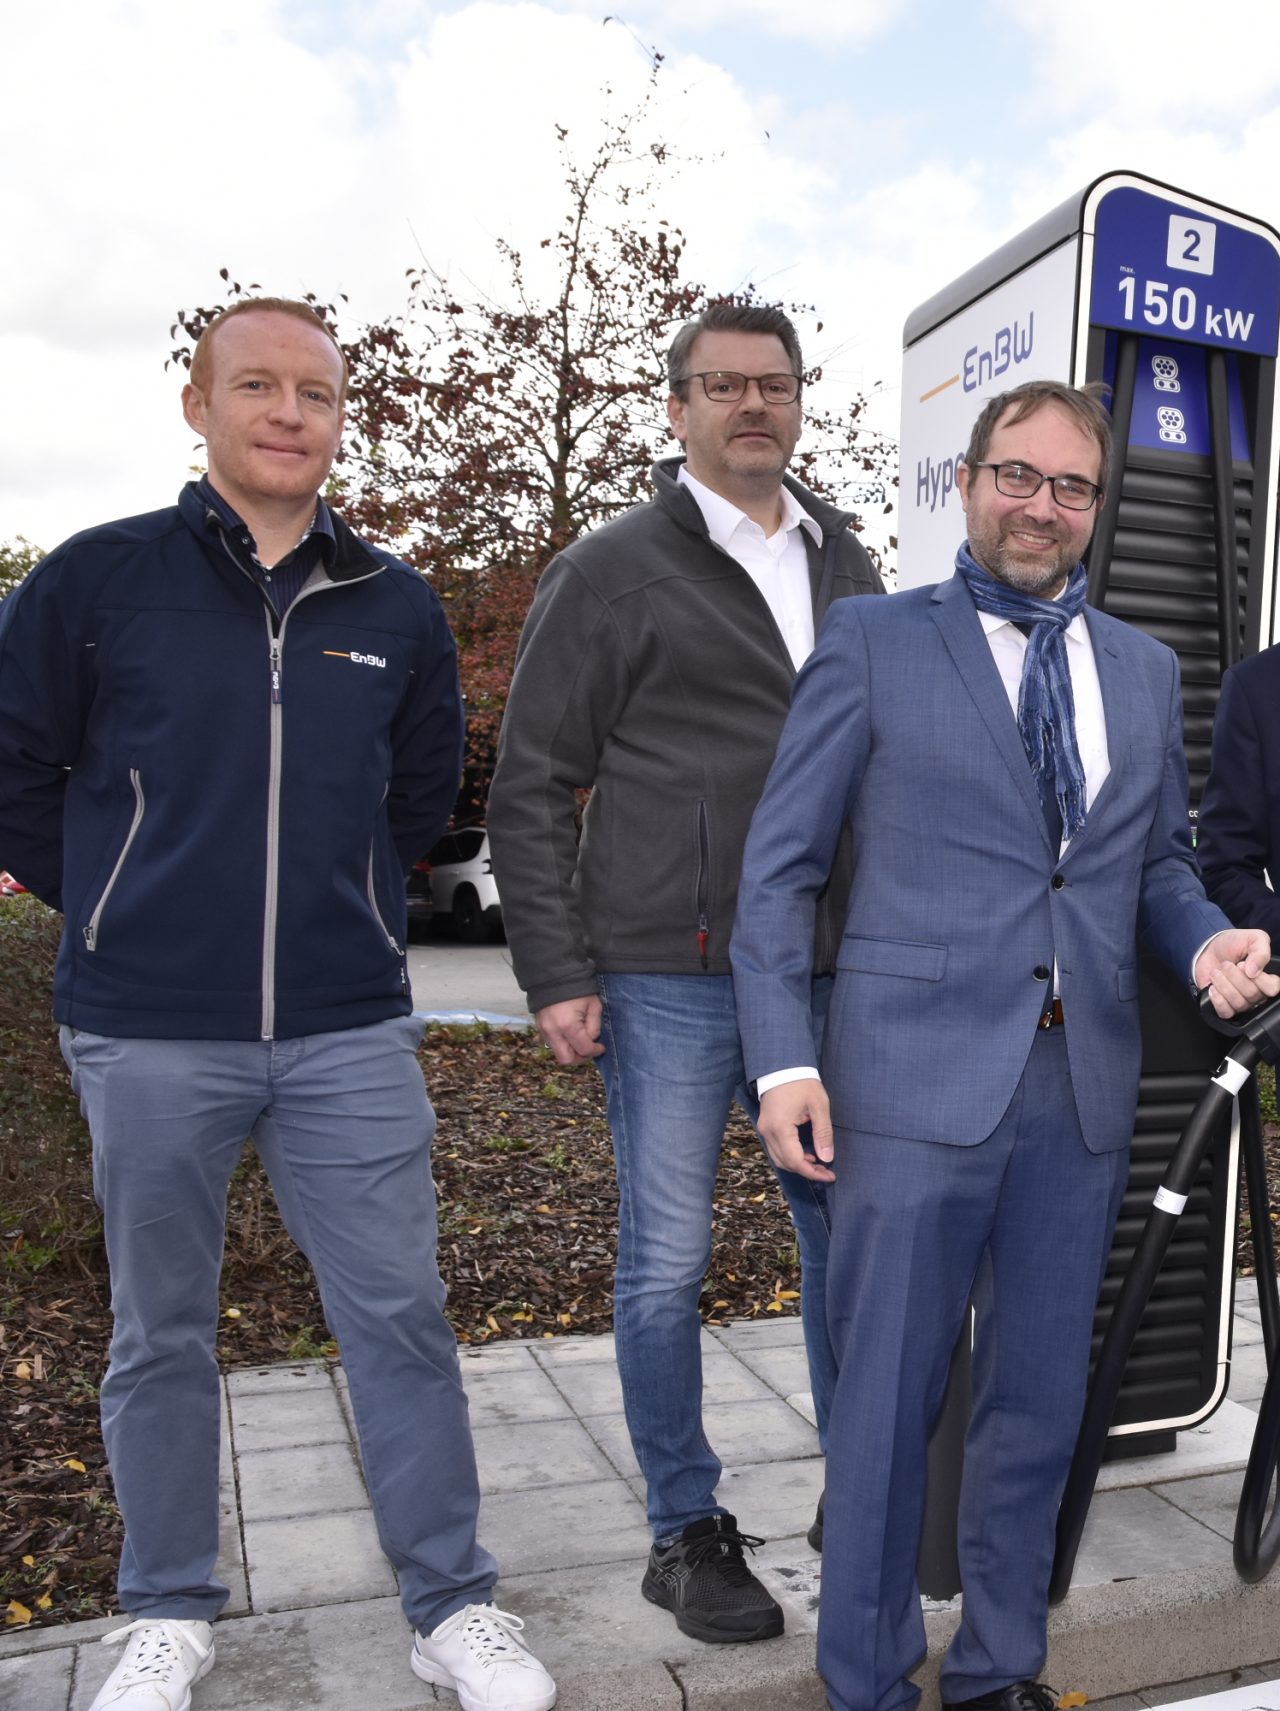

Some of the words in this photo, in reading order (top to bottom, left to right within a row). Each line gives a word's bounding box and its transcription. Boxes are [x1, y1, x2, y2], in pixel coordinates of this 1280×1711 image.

[1181, 228, 1202, 263] 2
[1118, 276, 1197, 331] 150
[1204, 304, 1255, 342] kW
[963, 311, 1034, 393] EnBW
[350, 651, 386, 668] EnBW
